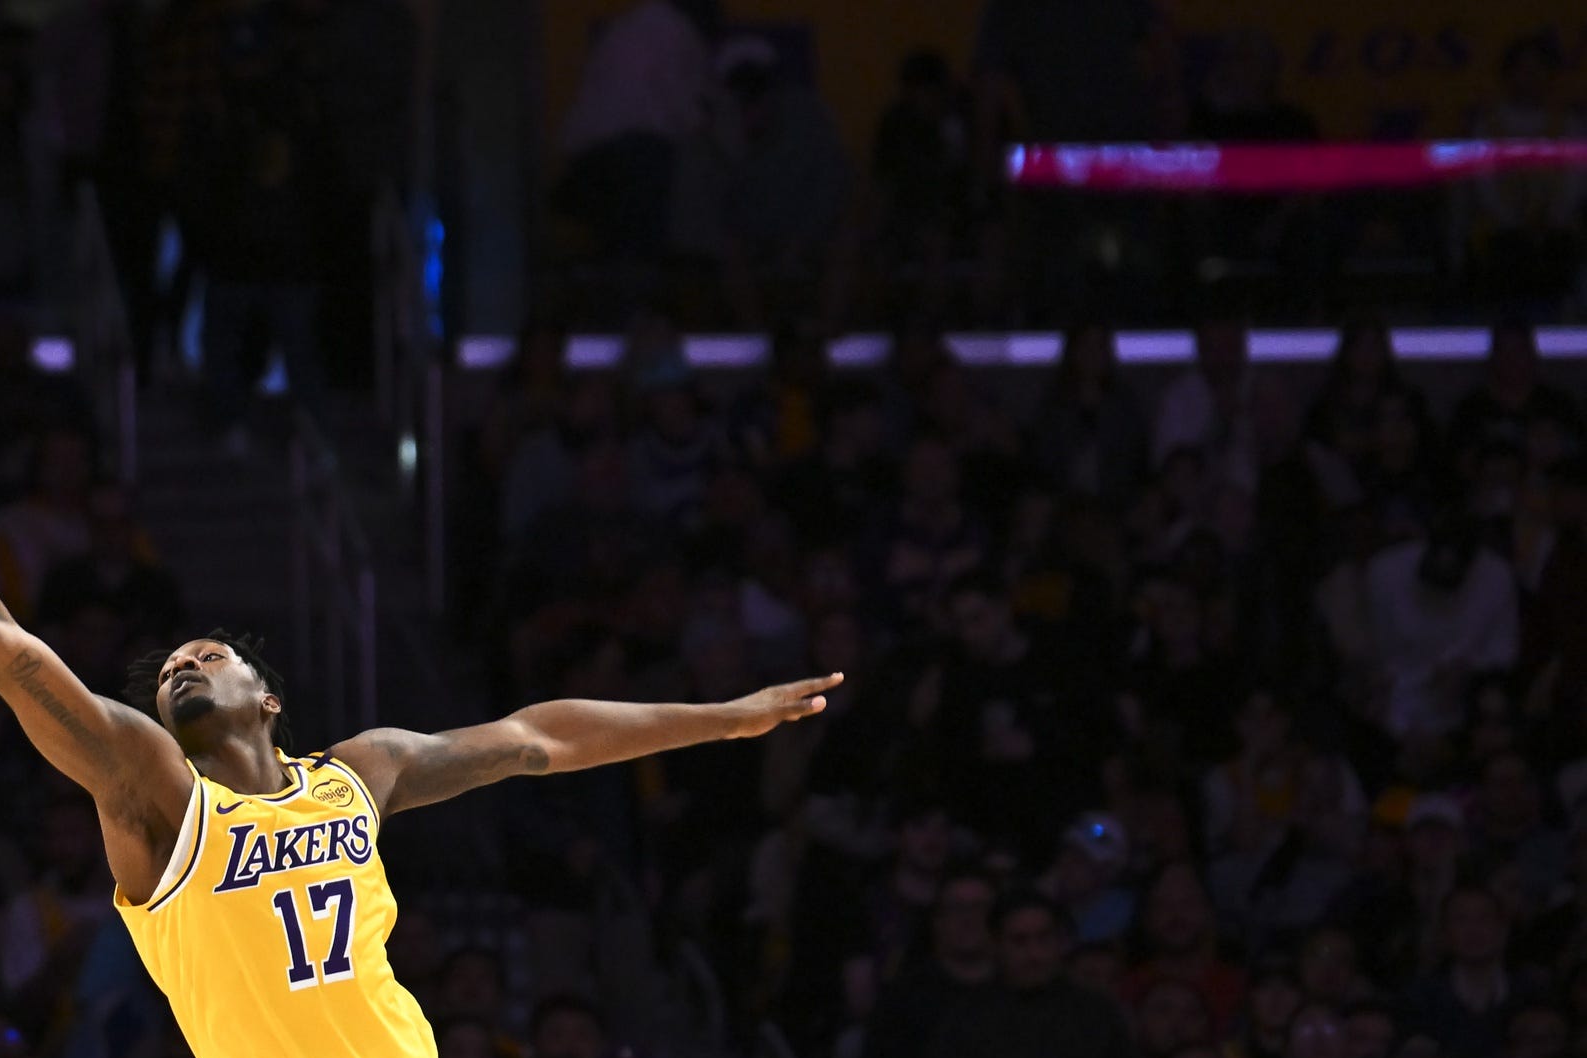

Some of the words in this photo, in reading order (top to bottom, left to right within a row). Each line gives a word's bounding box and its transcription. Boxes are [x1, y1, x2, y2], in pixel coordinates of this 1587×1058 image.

[315, 785, 349, 802] bibigo
[212, 814, 373, 895] LAKERS
[272, 878, 356, 990] 17
